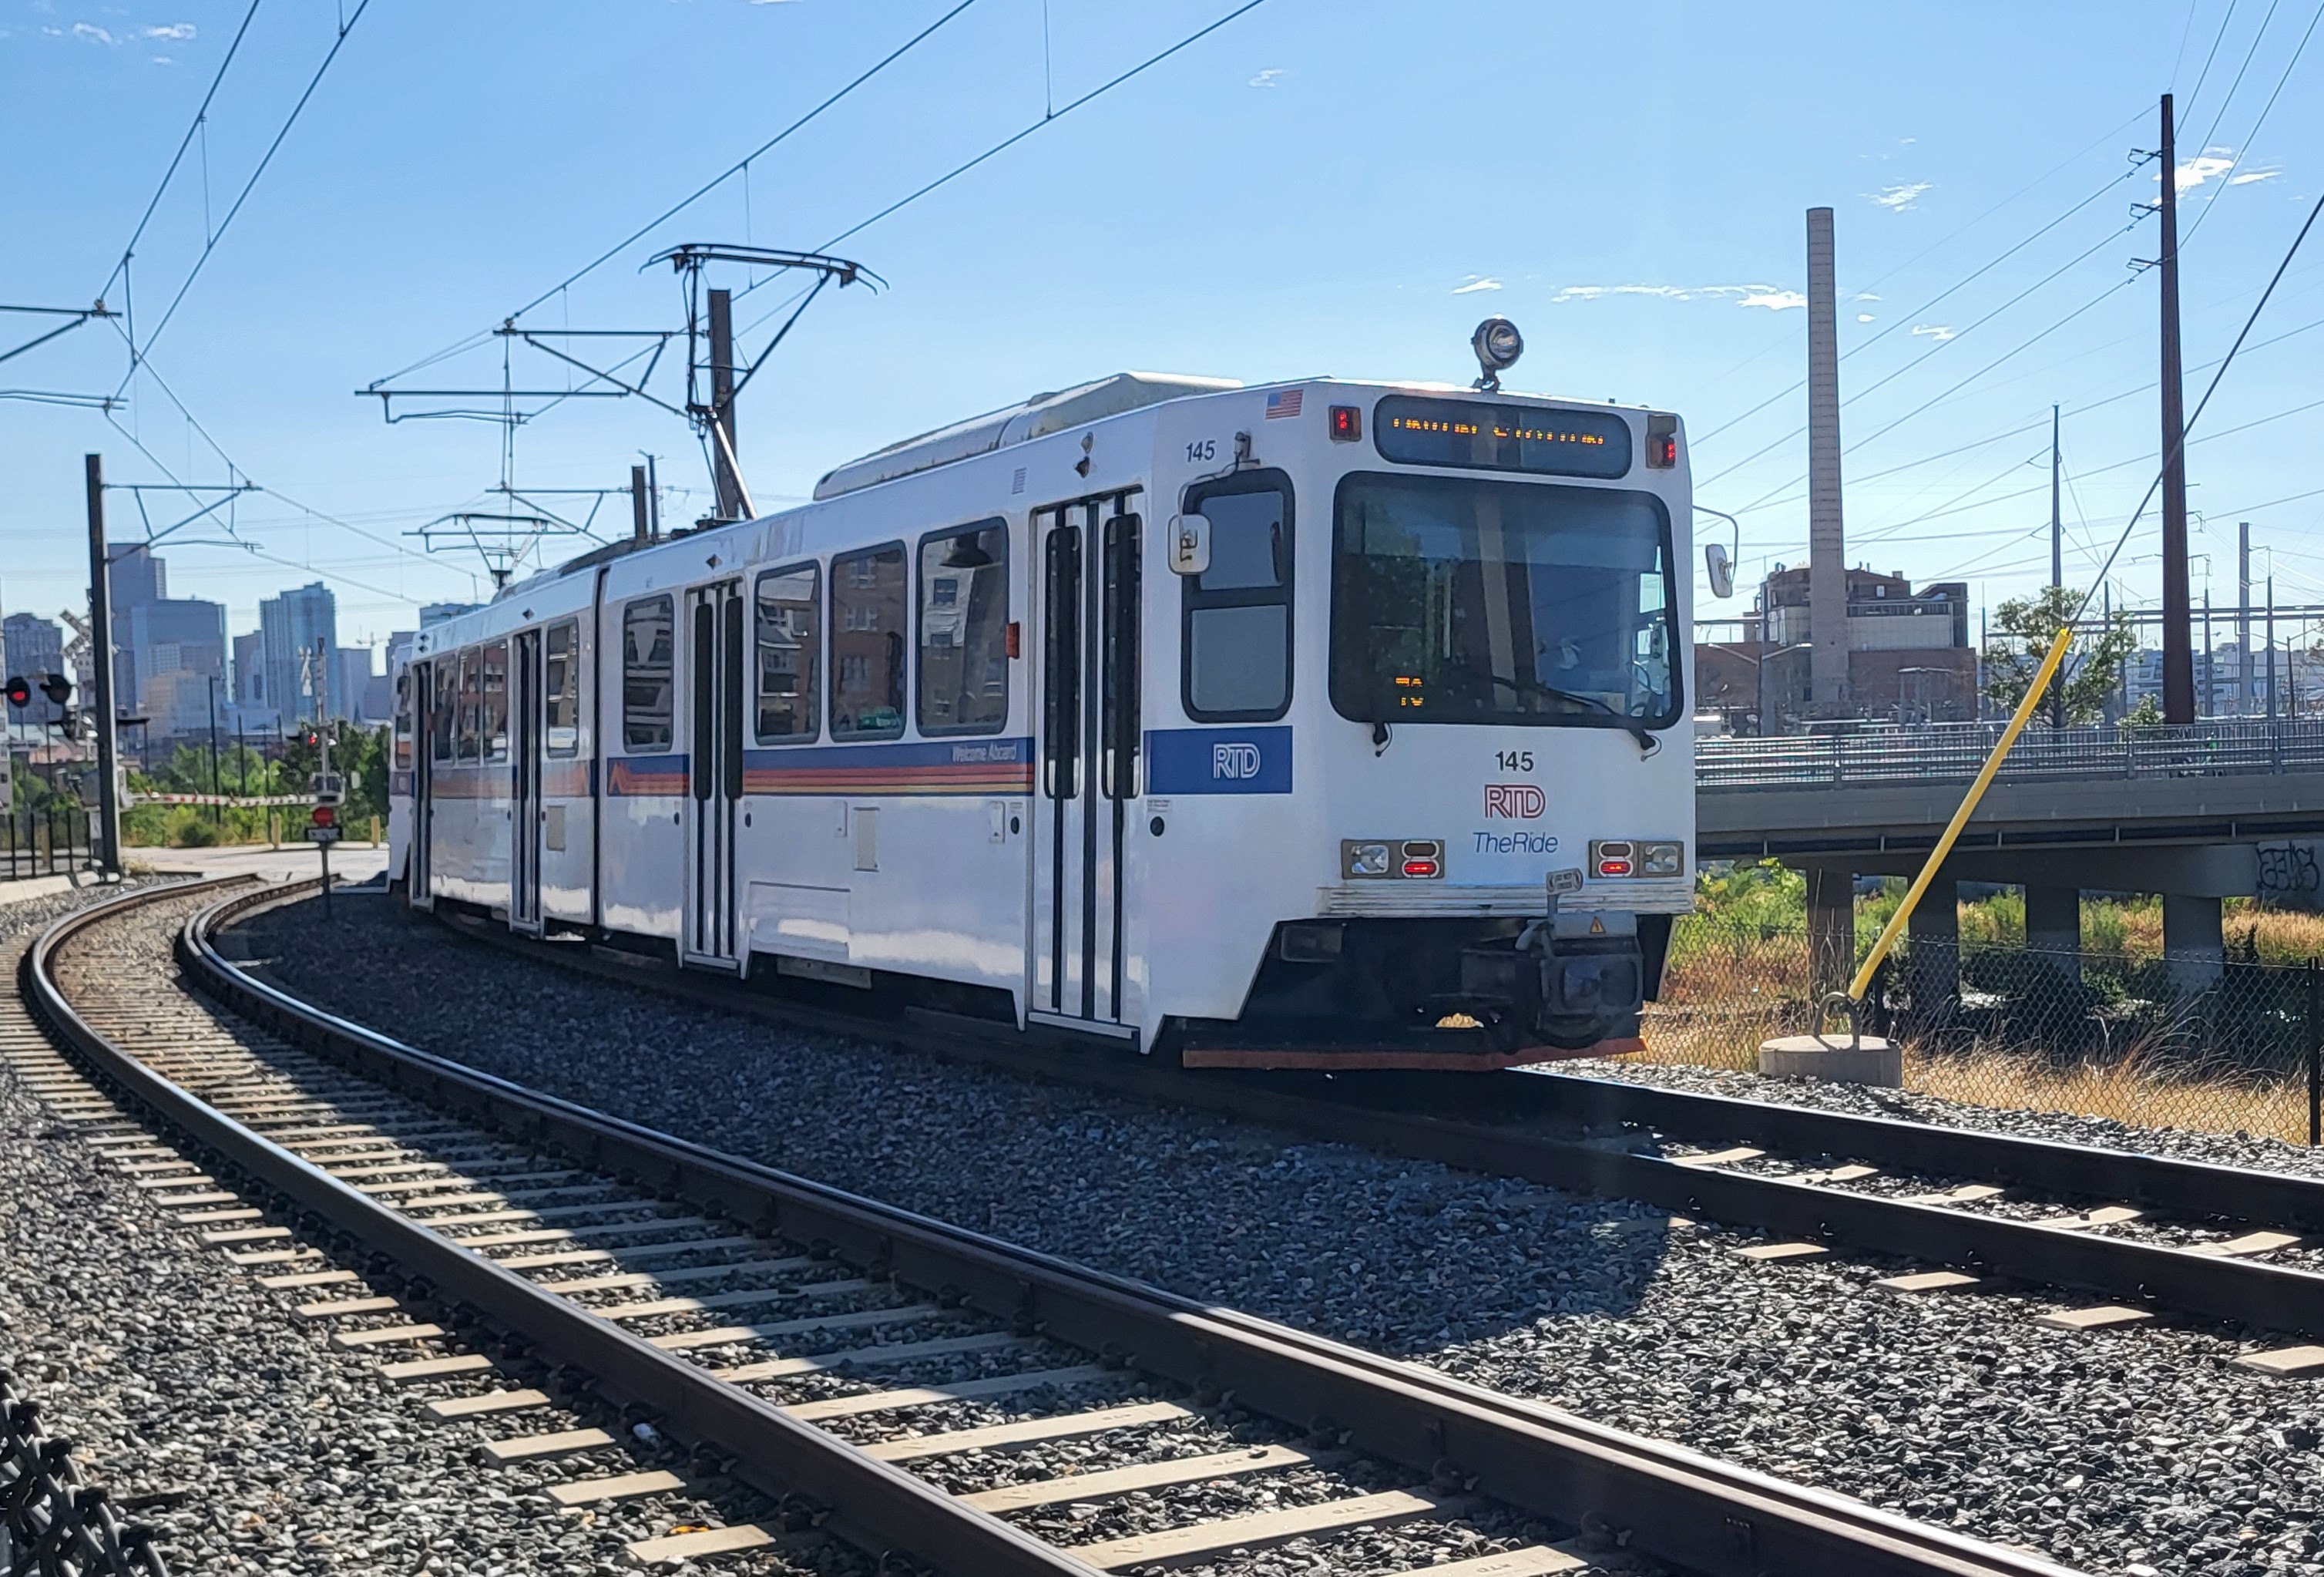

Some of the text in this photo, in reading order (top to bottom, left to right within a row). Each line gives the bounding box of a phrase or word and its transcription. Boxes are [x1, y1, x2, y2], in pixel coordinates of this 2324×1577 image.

[1186, 440, 1216, 462] 145
[1213, 743, 1261, 778] RTD
[1495, 751, 1534, 772] 145
[1484, 785, 1546, 819] RTD
[1473, 832, 1558, 853] TheRide
